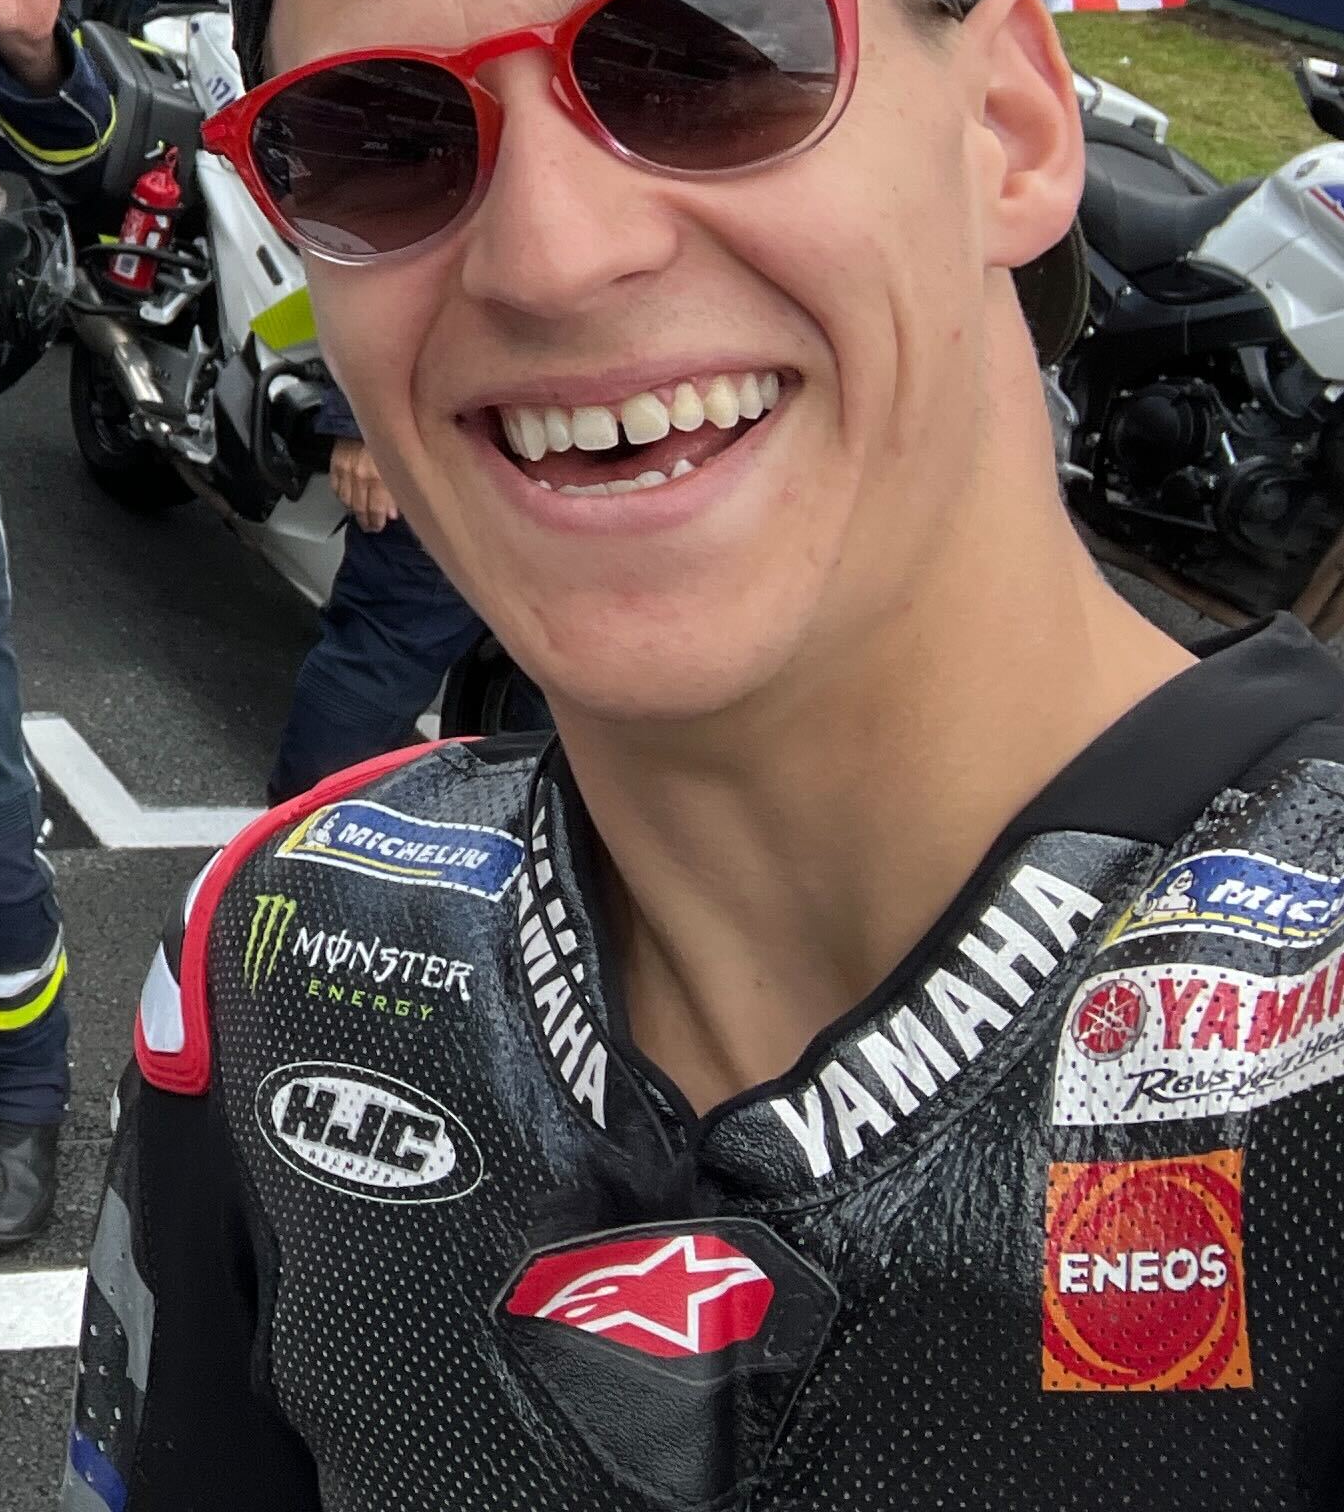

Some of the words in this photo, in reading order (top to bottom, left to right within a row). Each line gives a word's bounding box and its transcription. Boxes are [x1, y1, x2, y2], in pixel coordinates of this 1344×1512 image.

[338, 822, 492, 870] MICHELIN
[307, 979, 434, 1021] ENERGY
[771, 864, 1103, 1179] YAMAHA
[278, 1080, 446, 1176] HJC
[1058, 1244, 1228, 1294] ENEOS
